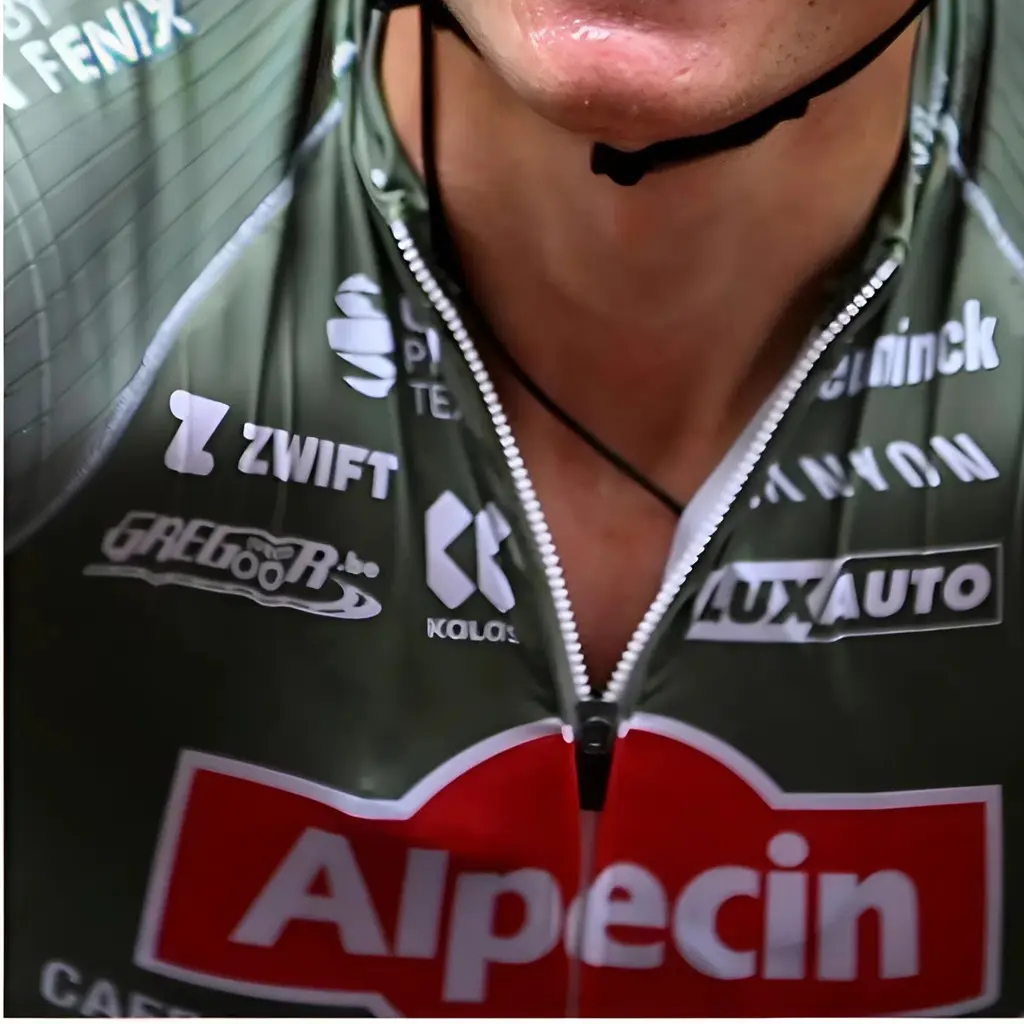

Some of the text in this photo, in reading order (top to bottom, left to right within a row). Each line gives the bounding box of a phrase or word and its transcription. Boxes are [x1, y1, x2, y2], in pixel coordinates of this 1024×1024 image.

[238, 422, 398, 499] ZWIFT
[749, 433, 1000, 509] ANYON
[228, 826, 920, 1003] Alpecin
